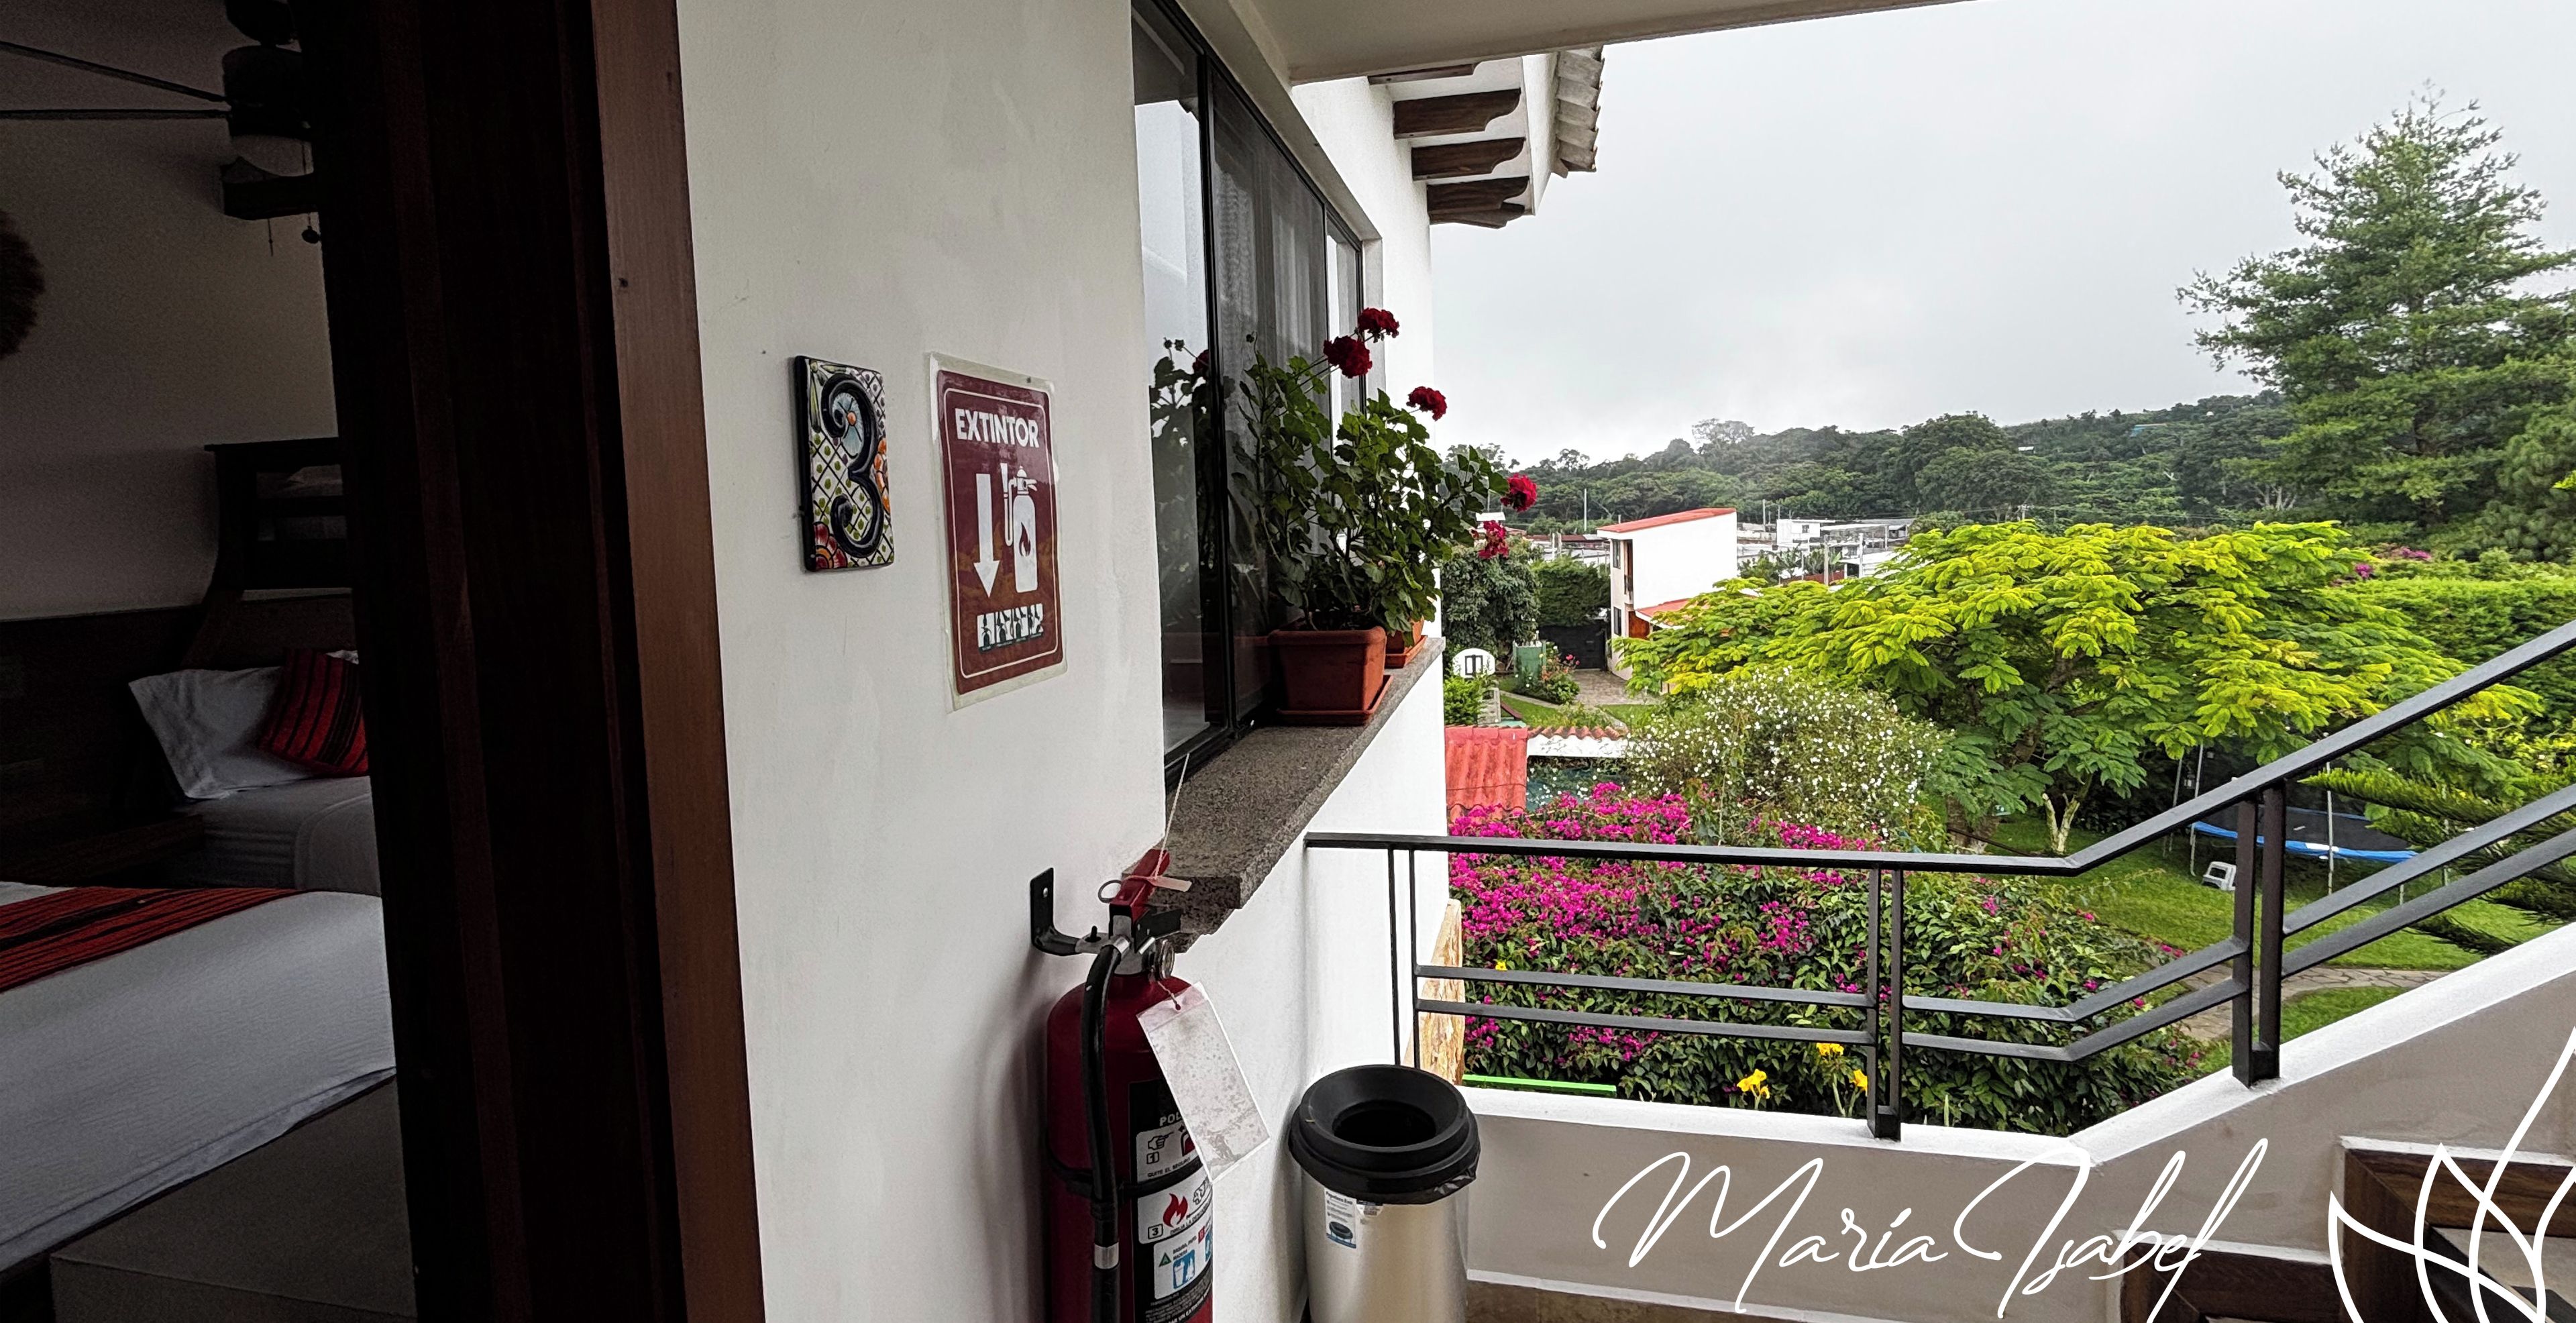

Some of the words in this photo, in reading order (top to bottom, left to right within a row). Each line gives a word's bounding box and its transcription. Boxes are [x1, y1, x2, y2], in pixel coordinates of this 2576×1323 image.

[955, 408, 1040, 448] EXTINTOR
[822, 373, 884, 559] 3
[1159, 1112, 1182, 1126] POL
[1148, 1169, 1164, 1177] QUITE
